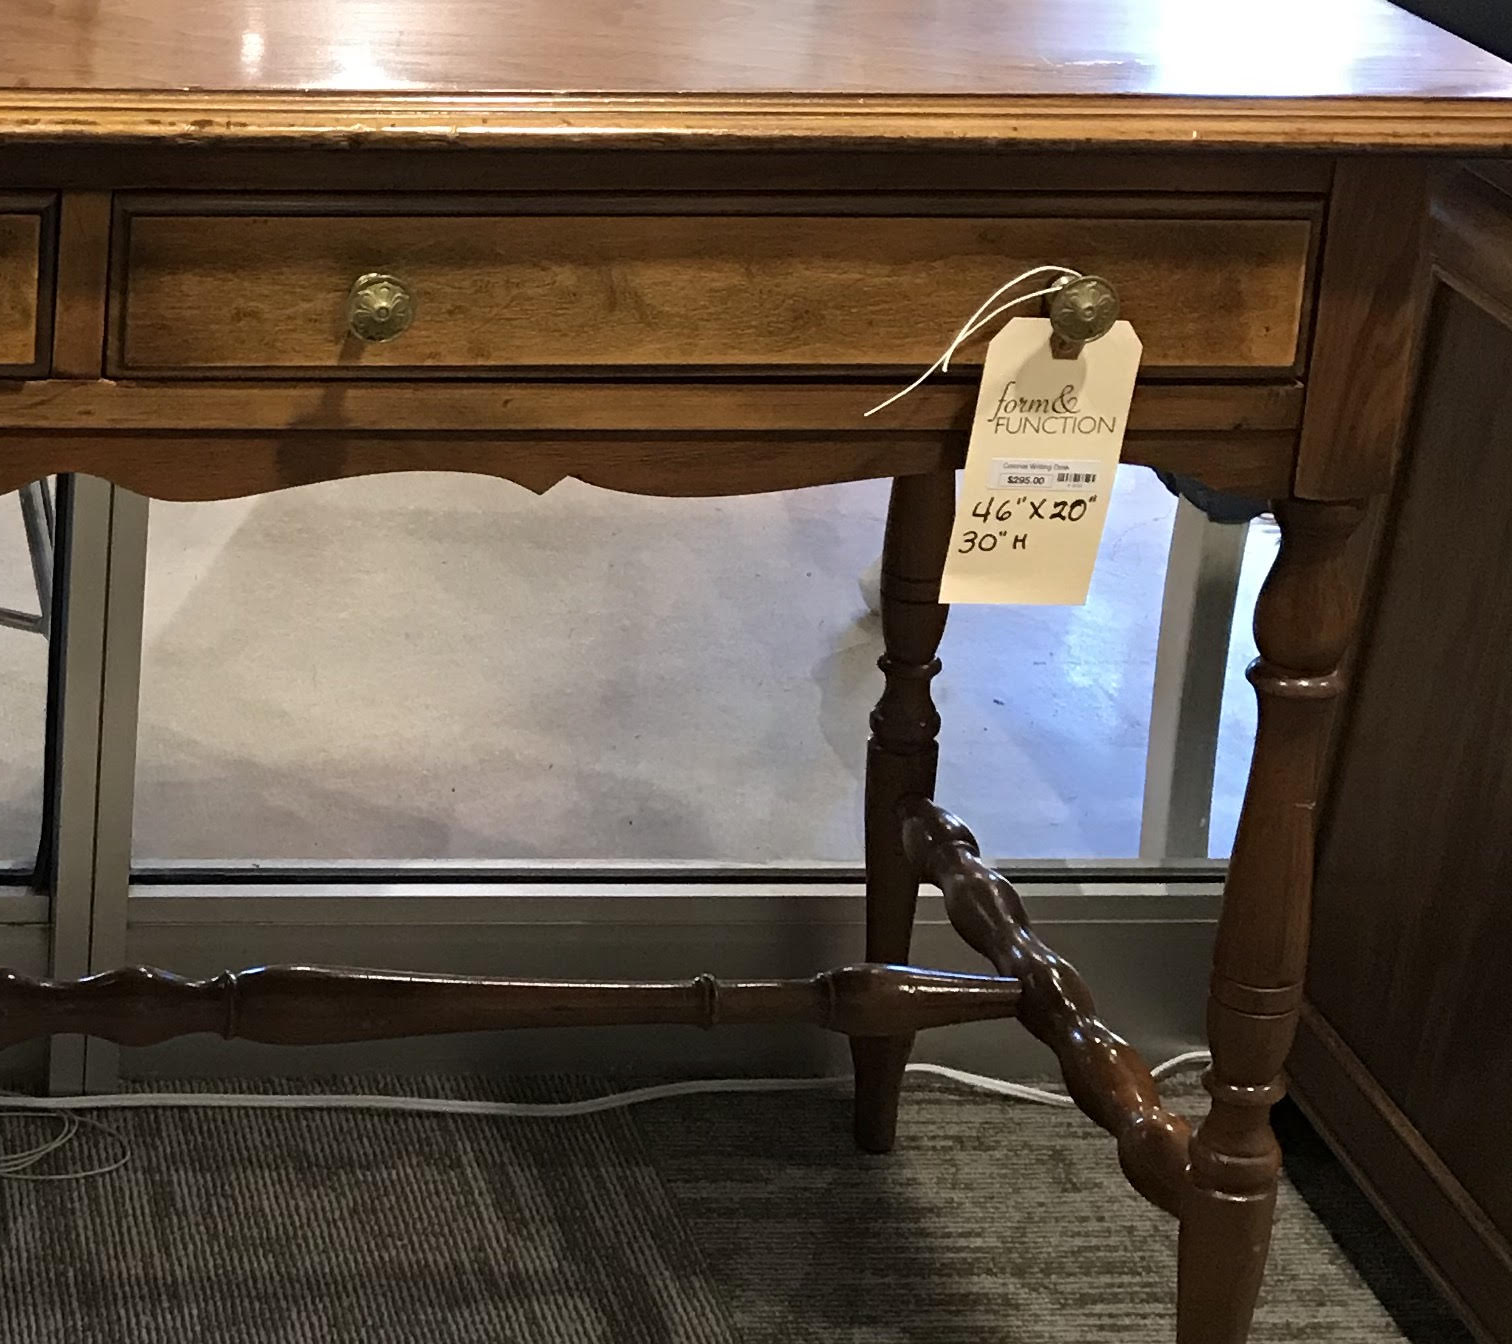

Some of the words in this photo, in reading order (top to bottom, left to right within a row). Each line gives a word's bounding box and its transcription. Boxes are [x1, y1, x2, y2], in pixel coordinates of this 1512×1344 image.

[994, 416, 1116, 434] FUNCTION
[1007, 476, 1045, 485] $295.00
[1012, 533, 1028, 549] H
